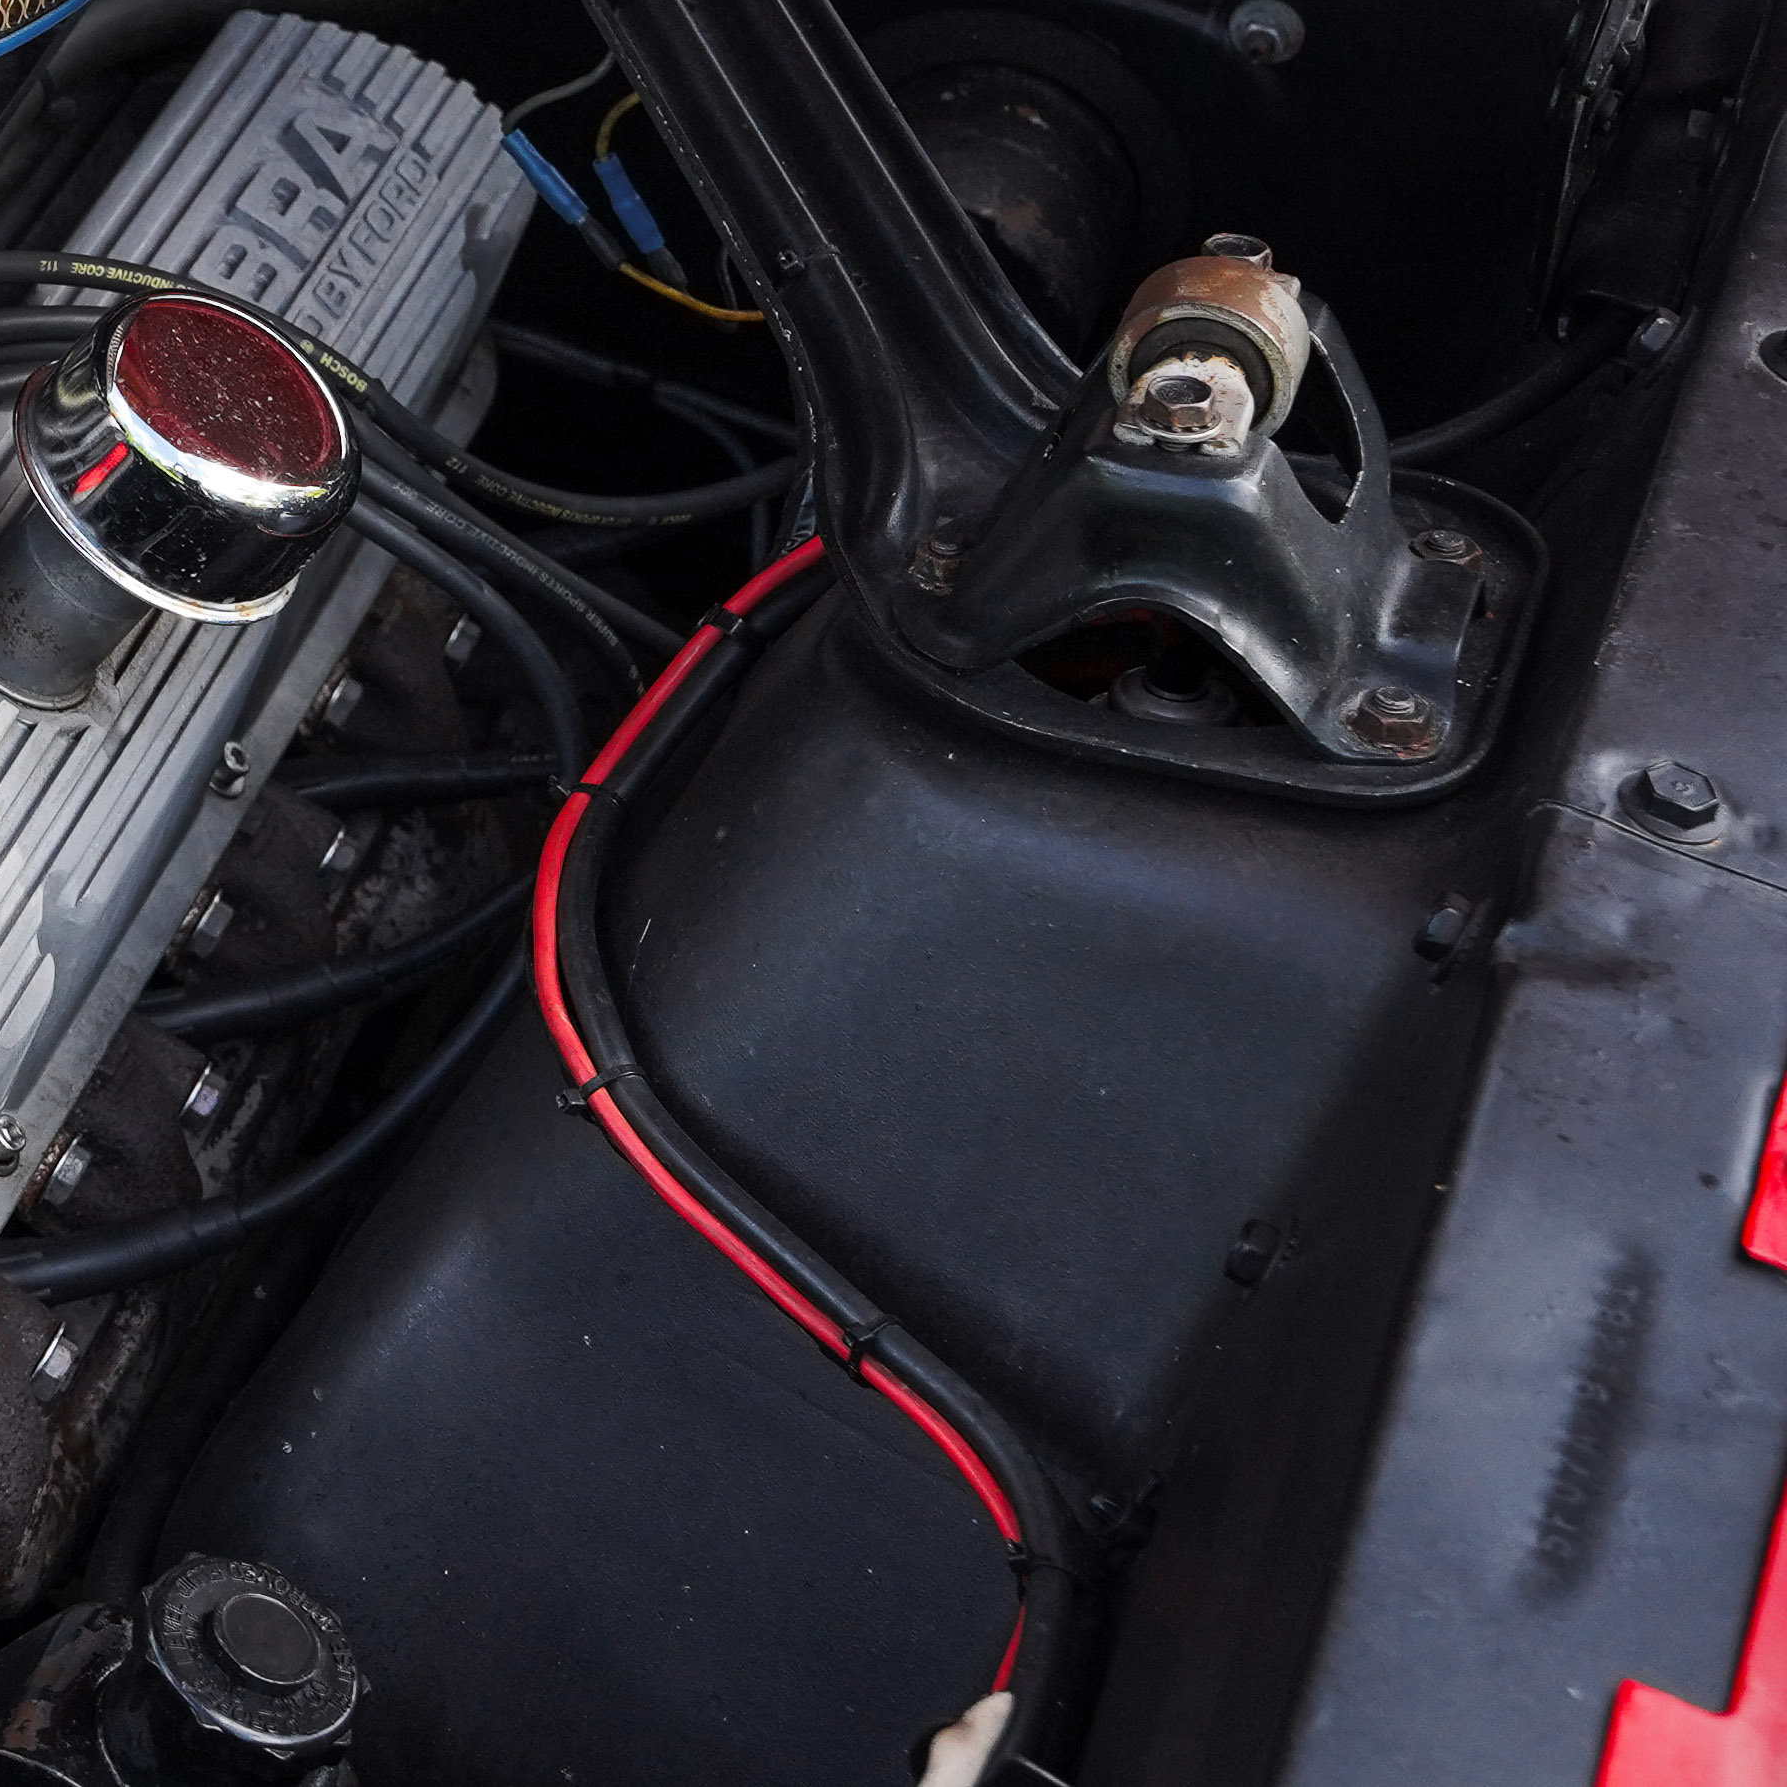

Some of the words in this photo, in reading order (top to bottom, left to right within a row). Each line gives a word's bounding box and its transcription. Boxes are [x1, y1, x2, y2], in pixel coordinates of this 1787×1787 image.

[38, 259, 59, 273] 112
[70, 261, 105, 277] CORE
[105, 265, 175, 290] INDUCTIVE
[319, 352, 368, 393] BOSCH
[584, 610, 620, 647] SUPER
